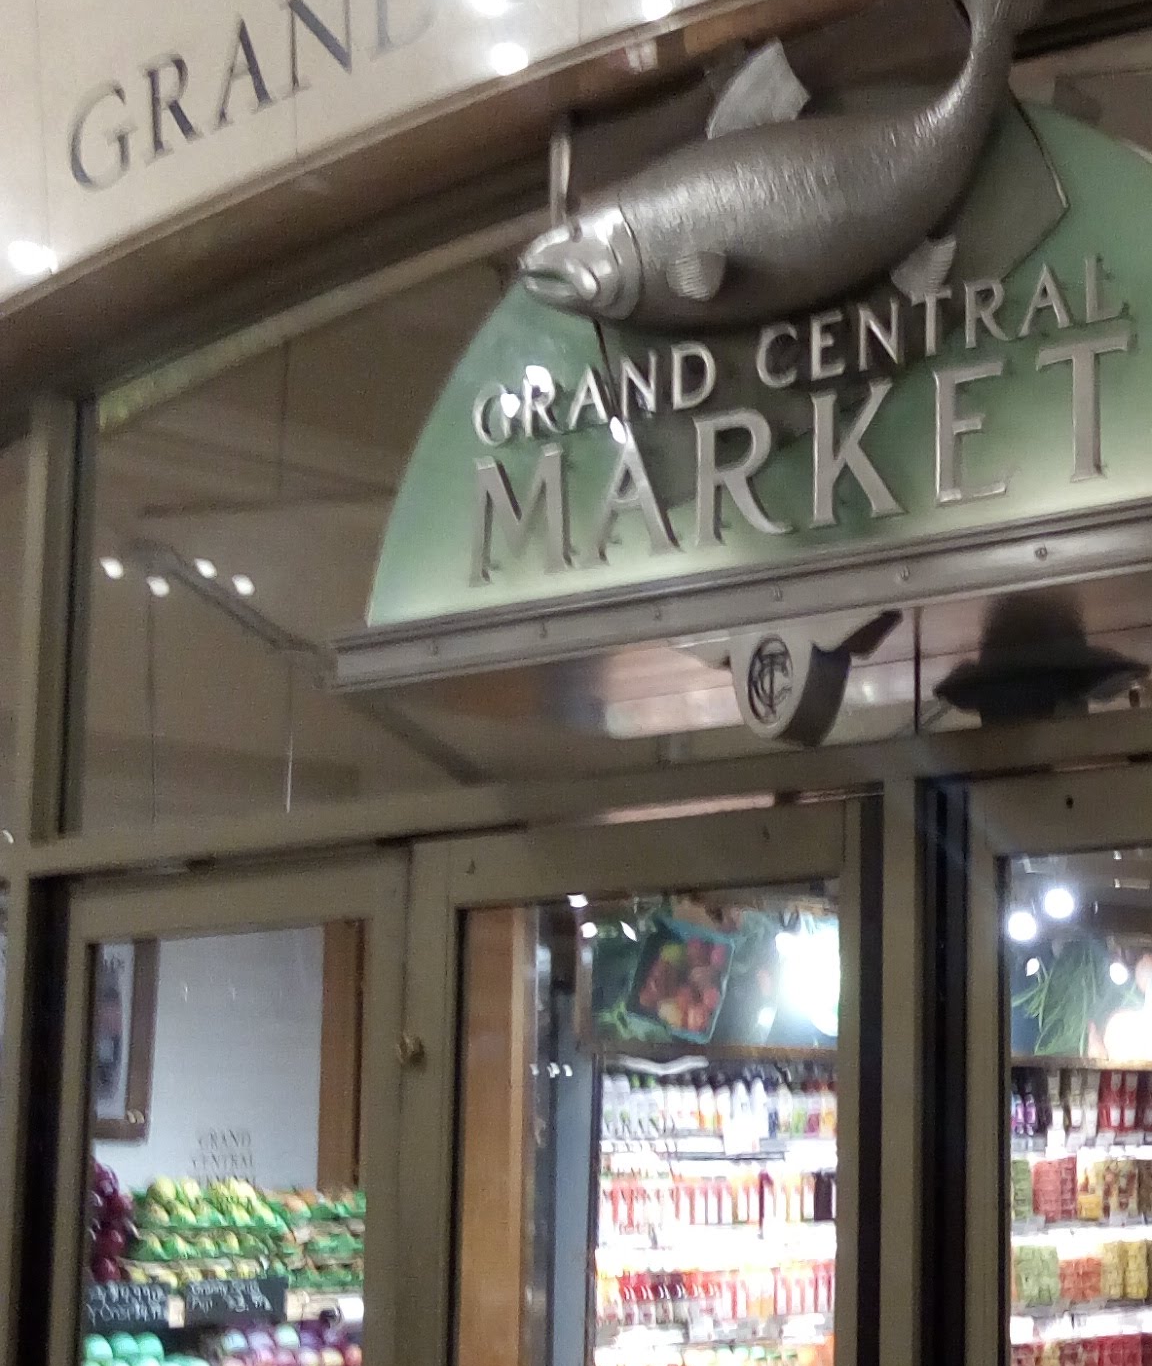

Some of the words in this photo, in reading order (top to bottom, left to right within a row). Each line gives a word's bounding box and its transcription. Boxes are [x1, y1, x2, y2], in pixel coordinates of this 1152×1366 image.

[467, 318, 1136, 589] MARKET
[472, 341, 717, 446] GRAND
[757, 254, 1129, 388] CENTRAL
